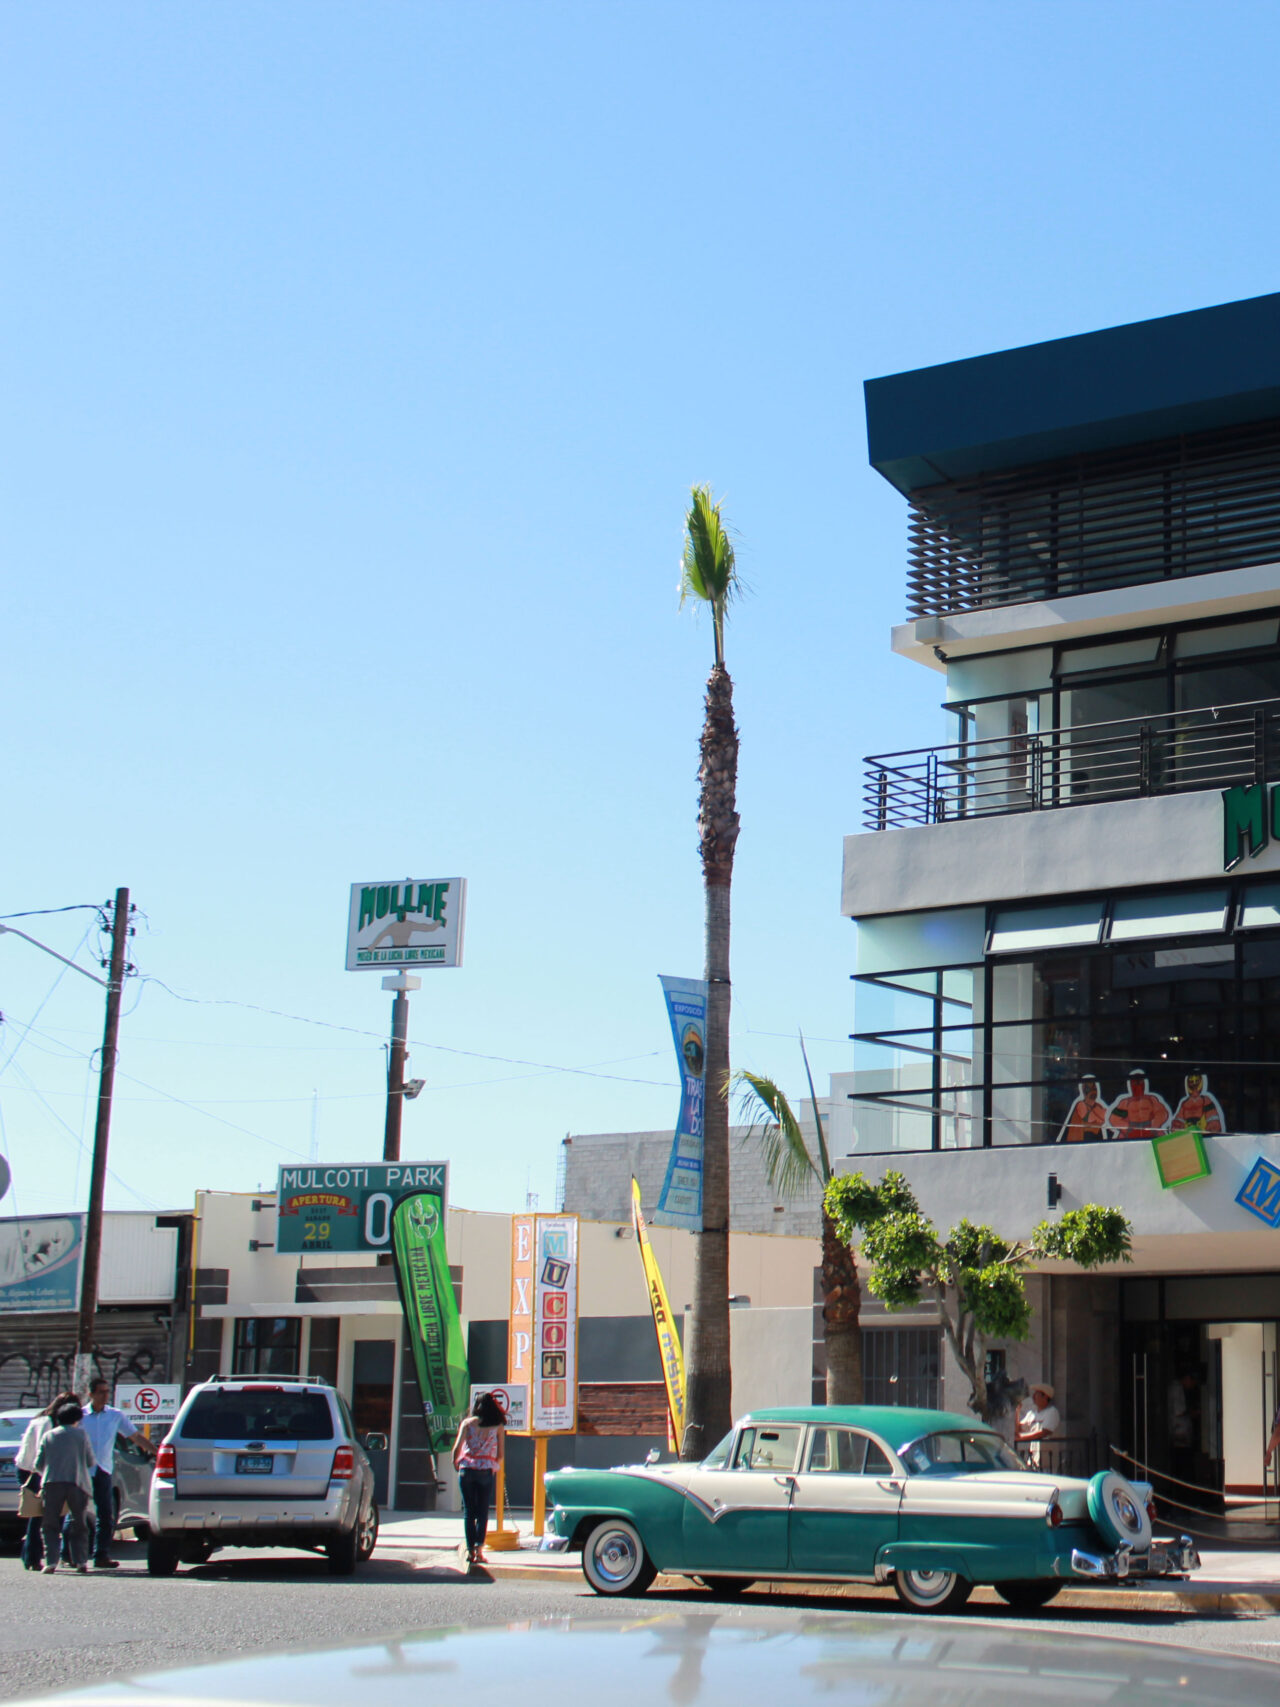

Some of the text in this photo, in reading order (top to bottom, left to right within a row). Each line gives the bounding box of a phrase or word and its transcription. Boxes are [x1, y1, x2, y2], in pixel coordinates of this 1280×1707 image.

[358, 883, 449, 932] MULLME
[282, 1167, 444, 1189] MULCOTI PARK
[291, 1194, 347, 1207] APERTURA
[304, 1223, 331, 1241] 29
